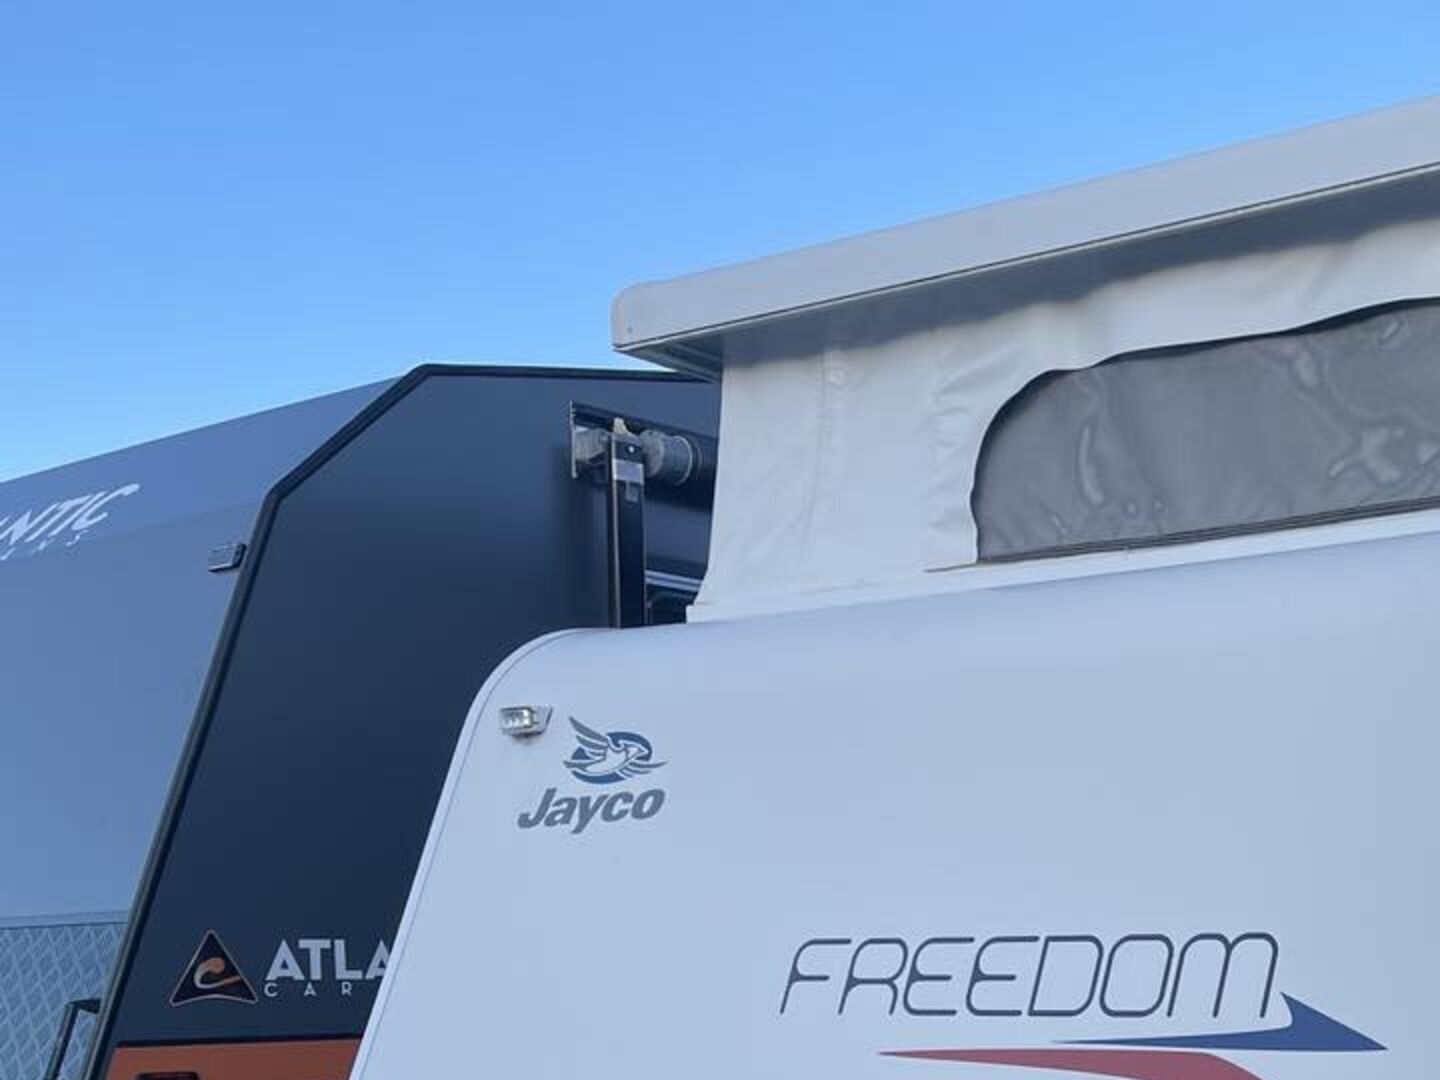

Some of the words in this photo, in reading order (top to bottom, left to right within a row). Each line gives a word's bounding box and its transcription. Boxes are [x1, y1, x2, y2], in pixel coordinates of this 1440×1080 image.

[0, 484, 140, 546] NTIC
[517, 787, 666, 834] Jayco
[779, 932, 1280, 1019] FREEDOM
